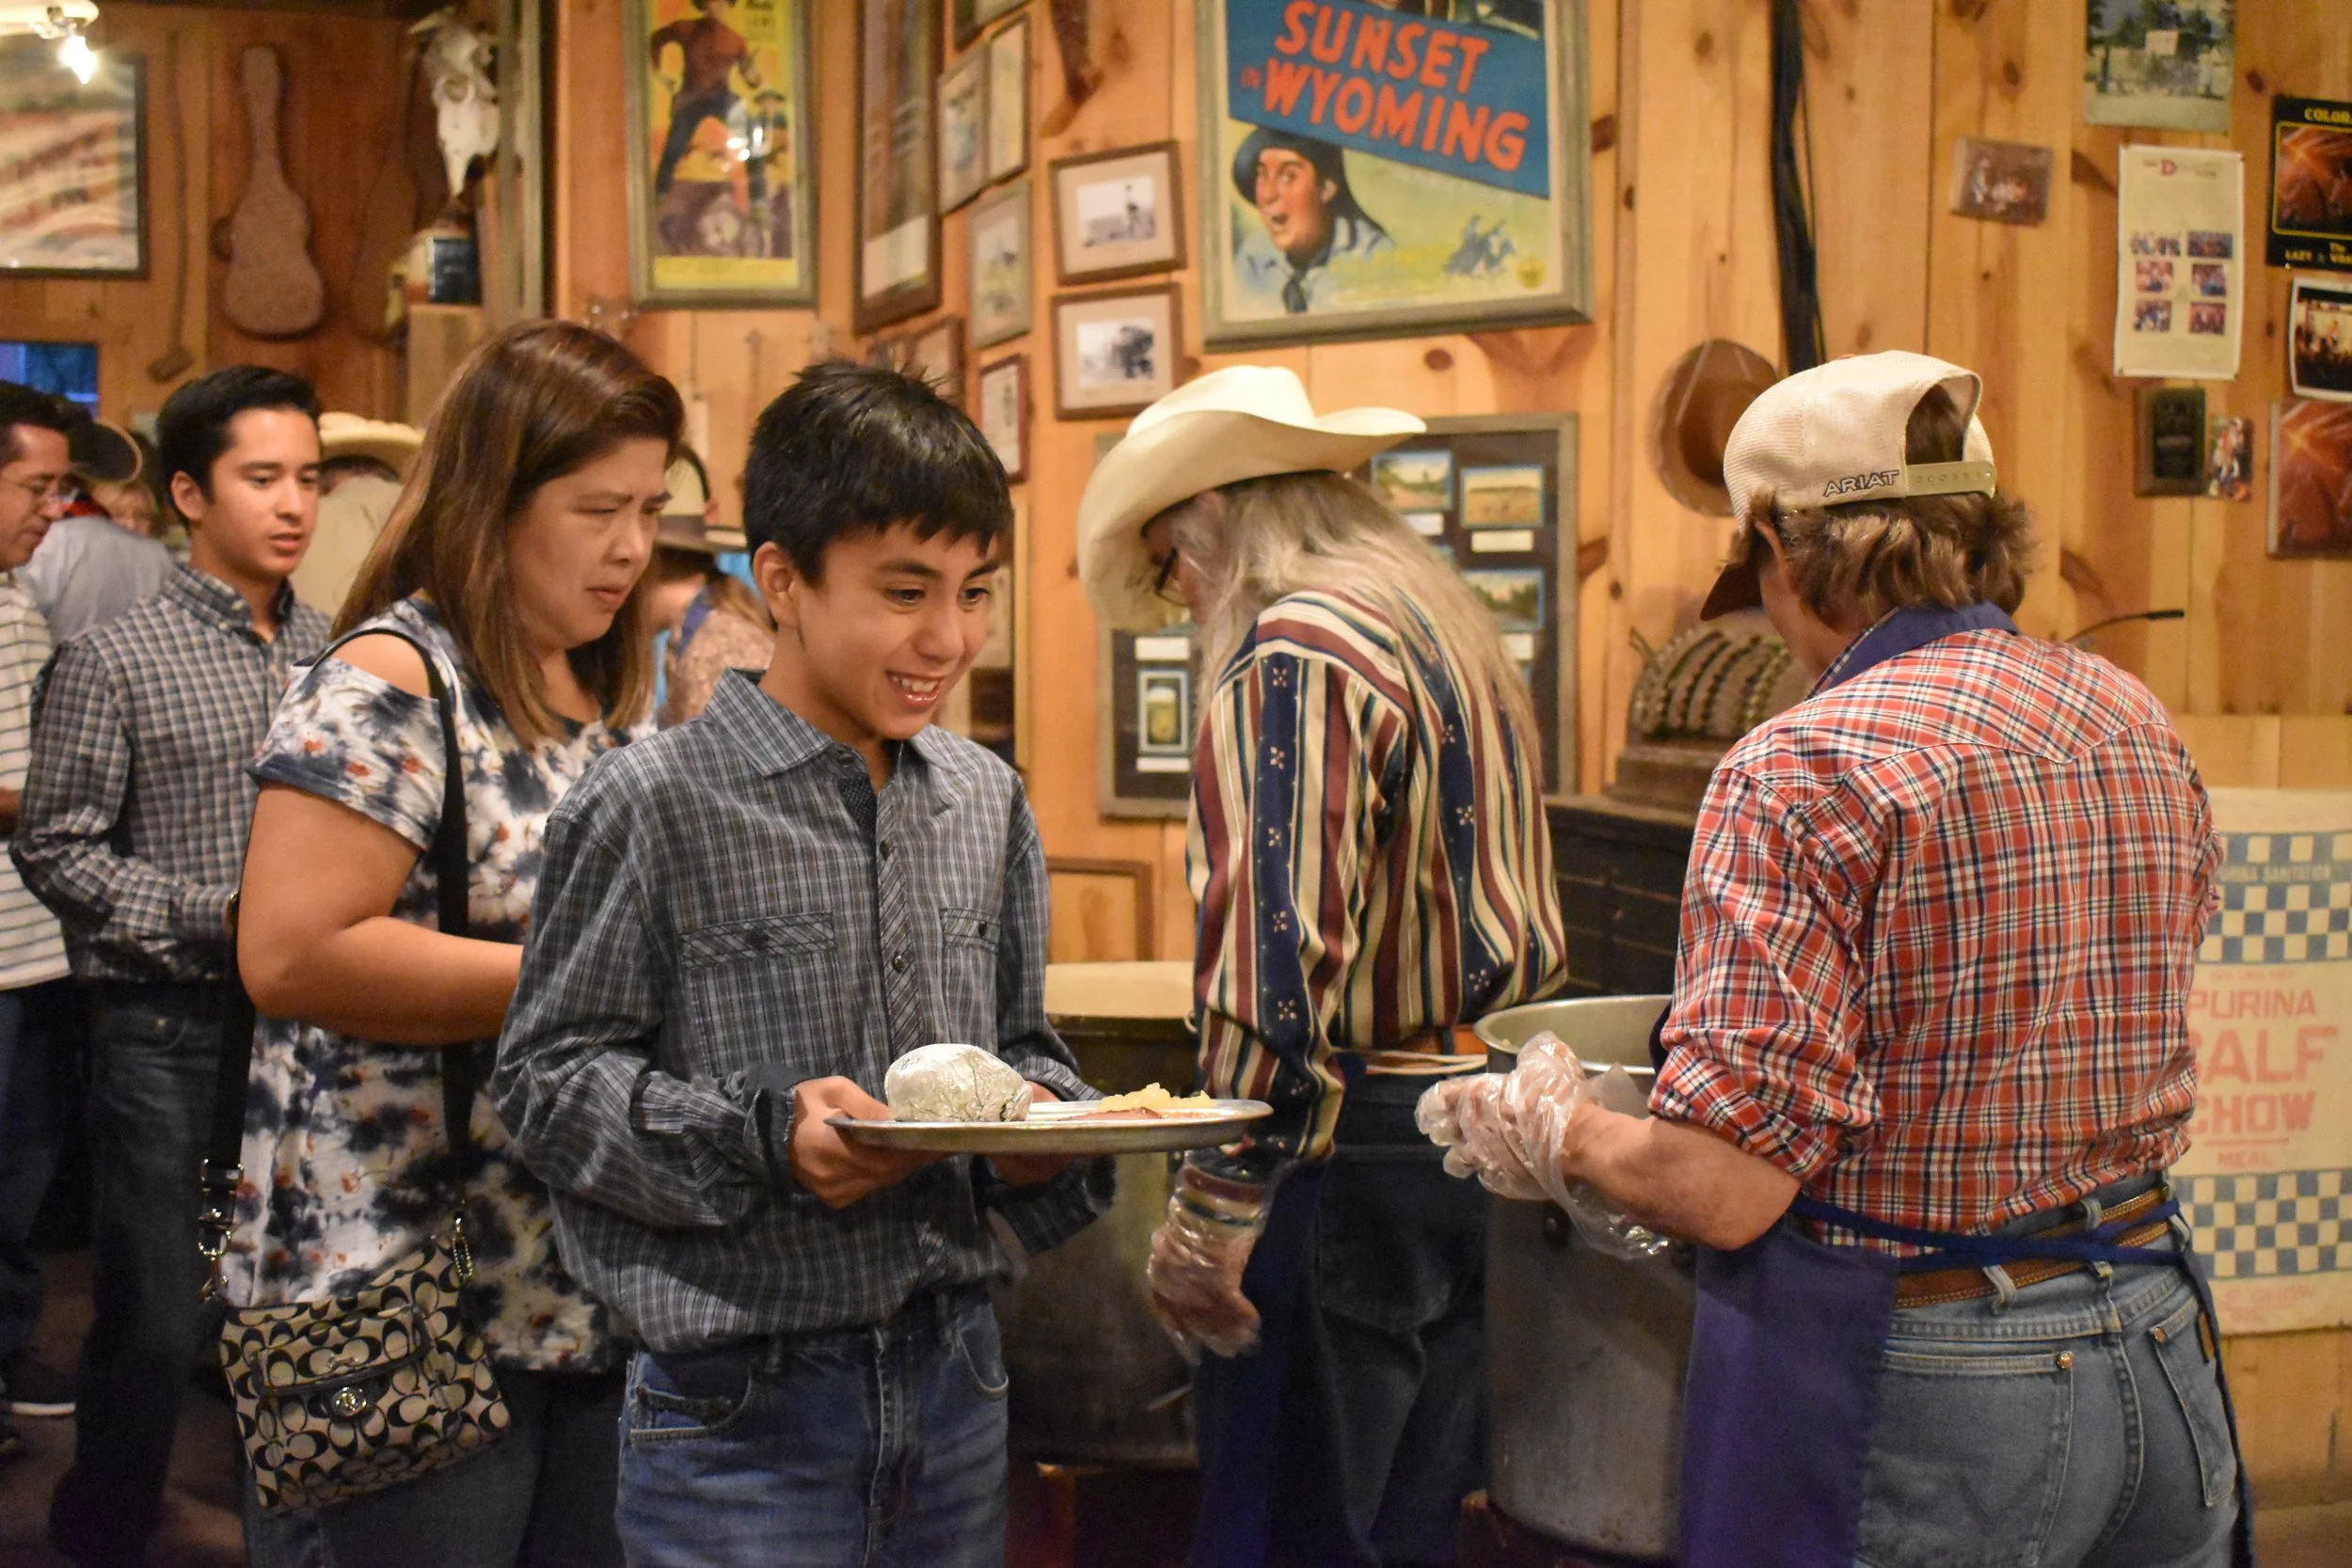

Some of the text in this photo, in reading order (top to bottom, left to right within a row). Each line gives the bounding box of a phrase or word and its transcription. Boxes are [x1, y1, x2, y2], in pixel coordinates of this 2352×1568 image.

[1275, 0, 1490, 93] SUNSET
[1263, 57, 1531, 171] WYOMING
[1823, 469, 1899, 498] ARIAT
[2186, 989, 2318, 1020] PURINA
